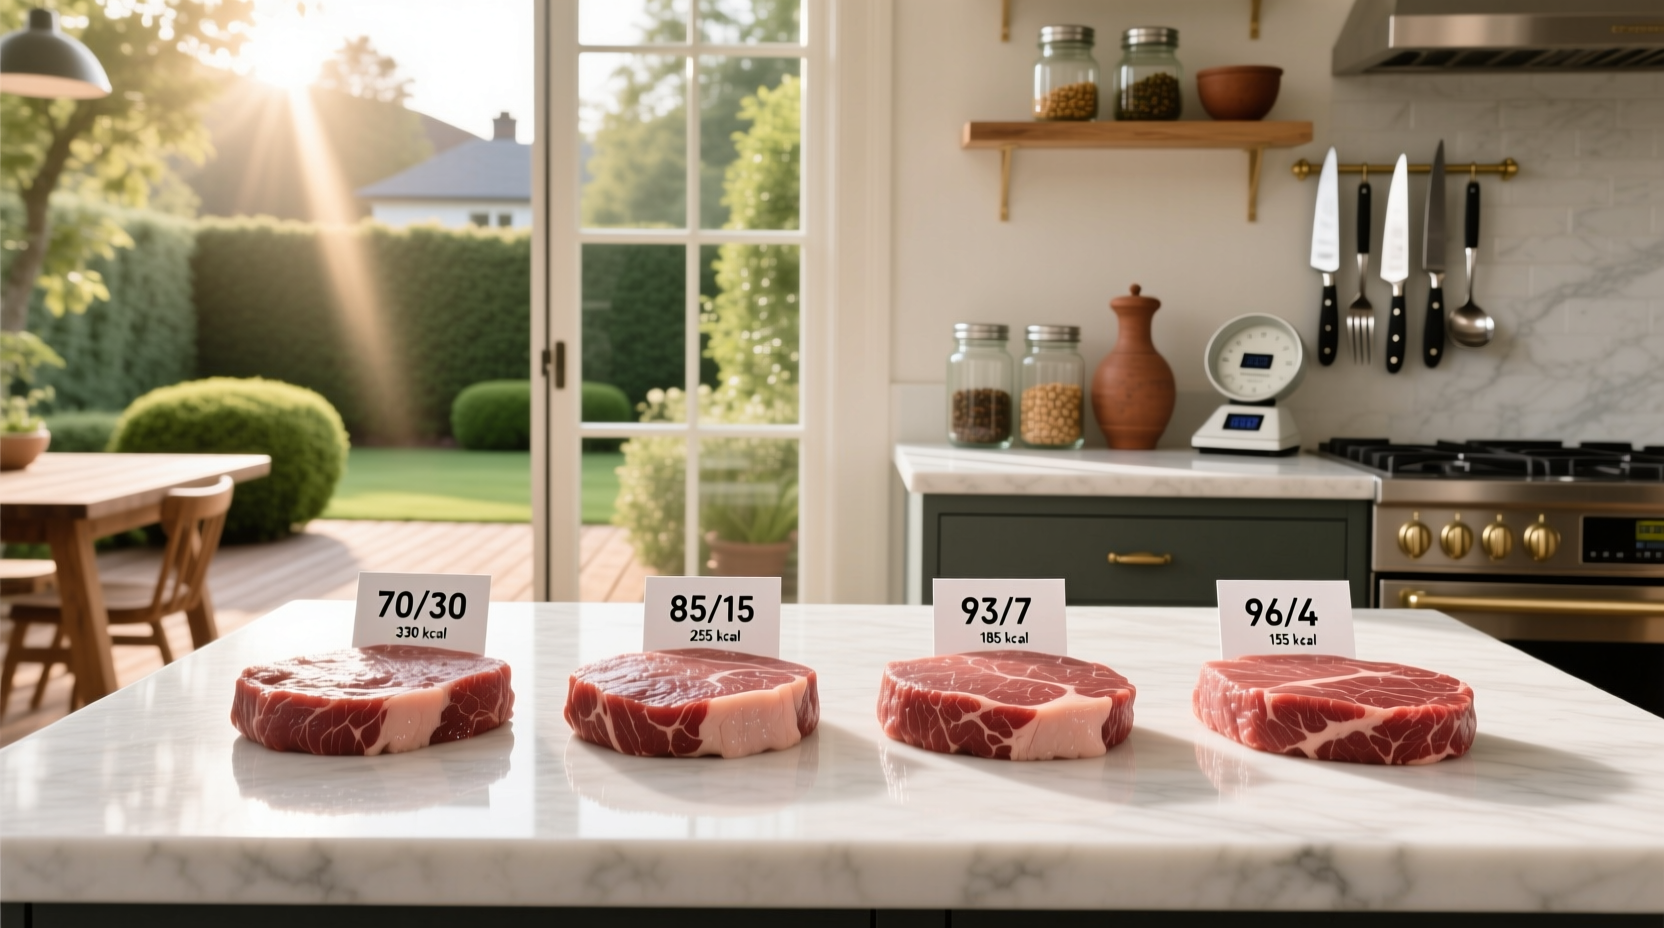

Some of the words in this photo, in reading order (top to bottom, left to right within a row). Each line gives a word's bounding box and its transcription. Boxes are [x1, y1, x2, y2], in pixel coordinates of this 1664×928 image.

[378, 589, 467, 621] 70/30
[669, 594, 755, 624] 85/15
[961, 596, 1032, 627] 93/7
[1244, 597, 1319, 628] 96/4
[421, 625, 448, 640] kcal
[689, 628, 713, 642] 255
[716, 628, 741, 643] kcal
[979, 631, 1002, 644] 185
[1004, 631, 1029, 644] kcal
[1269, 633, 1290, 646] 155
[1292, 632, 1317, 646] kcal
